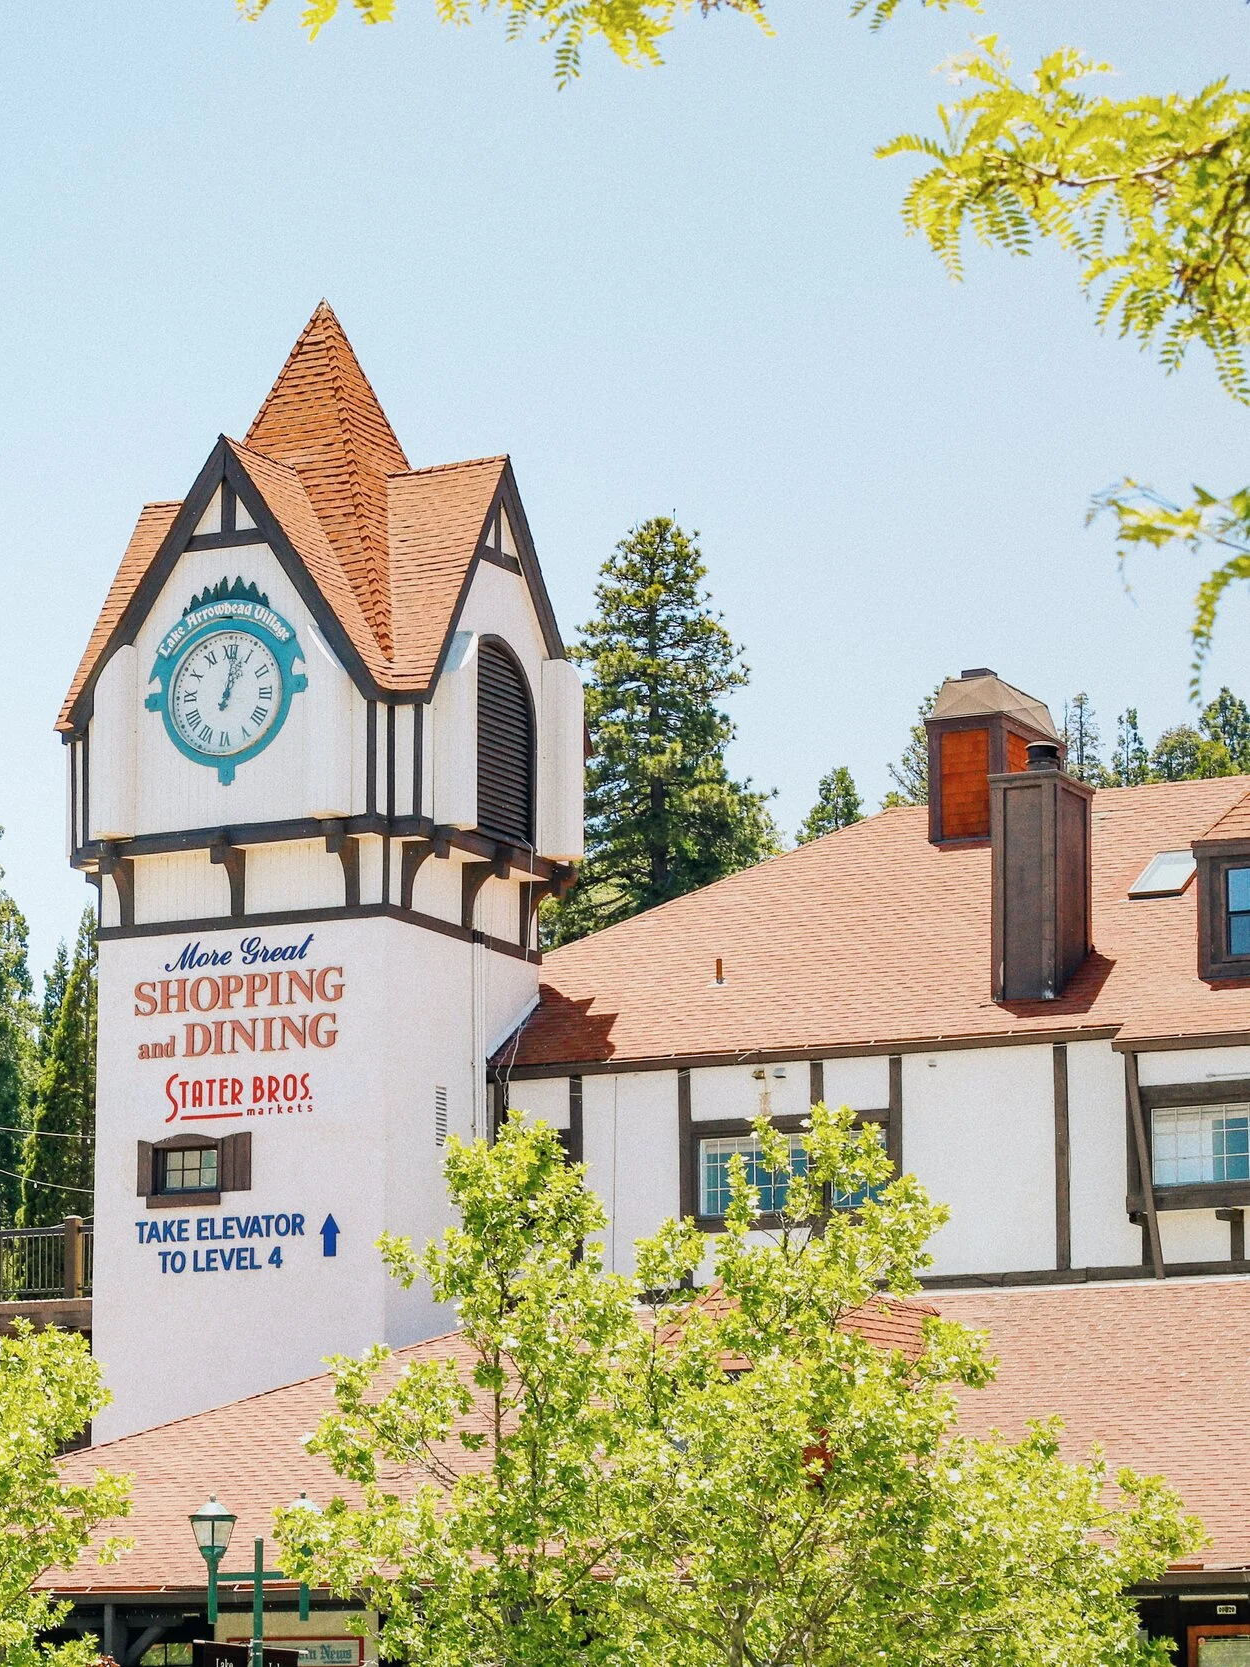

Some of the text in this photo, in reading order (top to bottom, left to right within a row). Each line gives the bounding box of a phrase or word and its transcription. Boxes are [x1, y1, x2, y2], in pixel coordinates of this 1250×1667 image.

[158, 603, 290, 657] Lake Arrowhead Village
[165, 933, 314, 973] More Great
[134, 966, 346, 1017] SHOPPING
[137, 1012, 339, 1060] and DINING
[165, 1072, 313, 1123] STATER BROS.
[246, 1103, 313, 1116] markets
[135, 1213, 305, 1244] TAKE ELEVATOR
[158, 1246, 283, 1274] TO LEVEL 4
